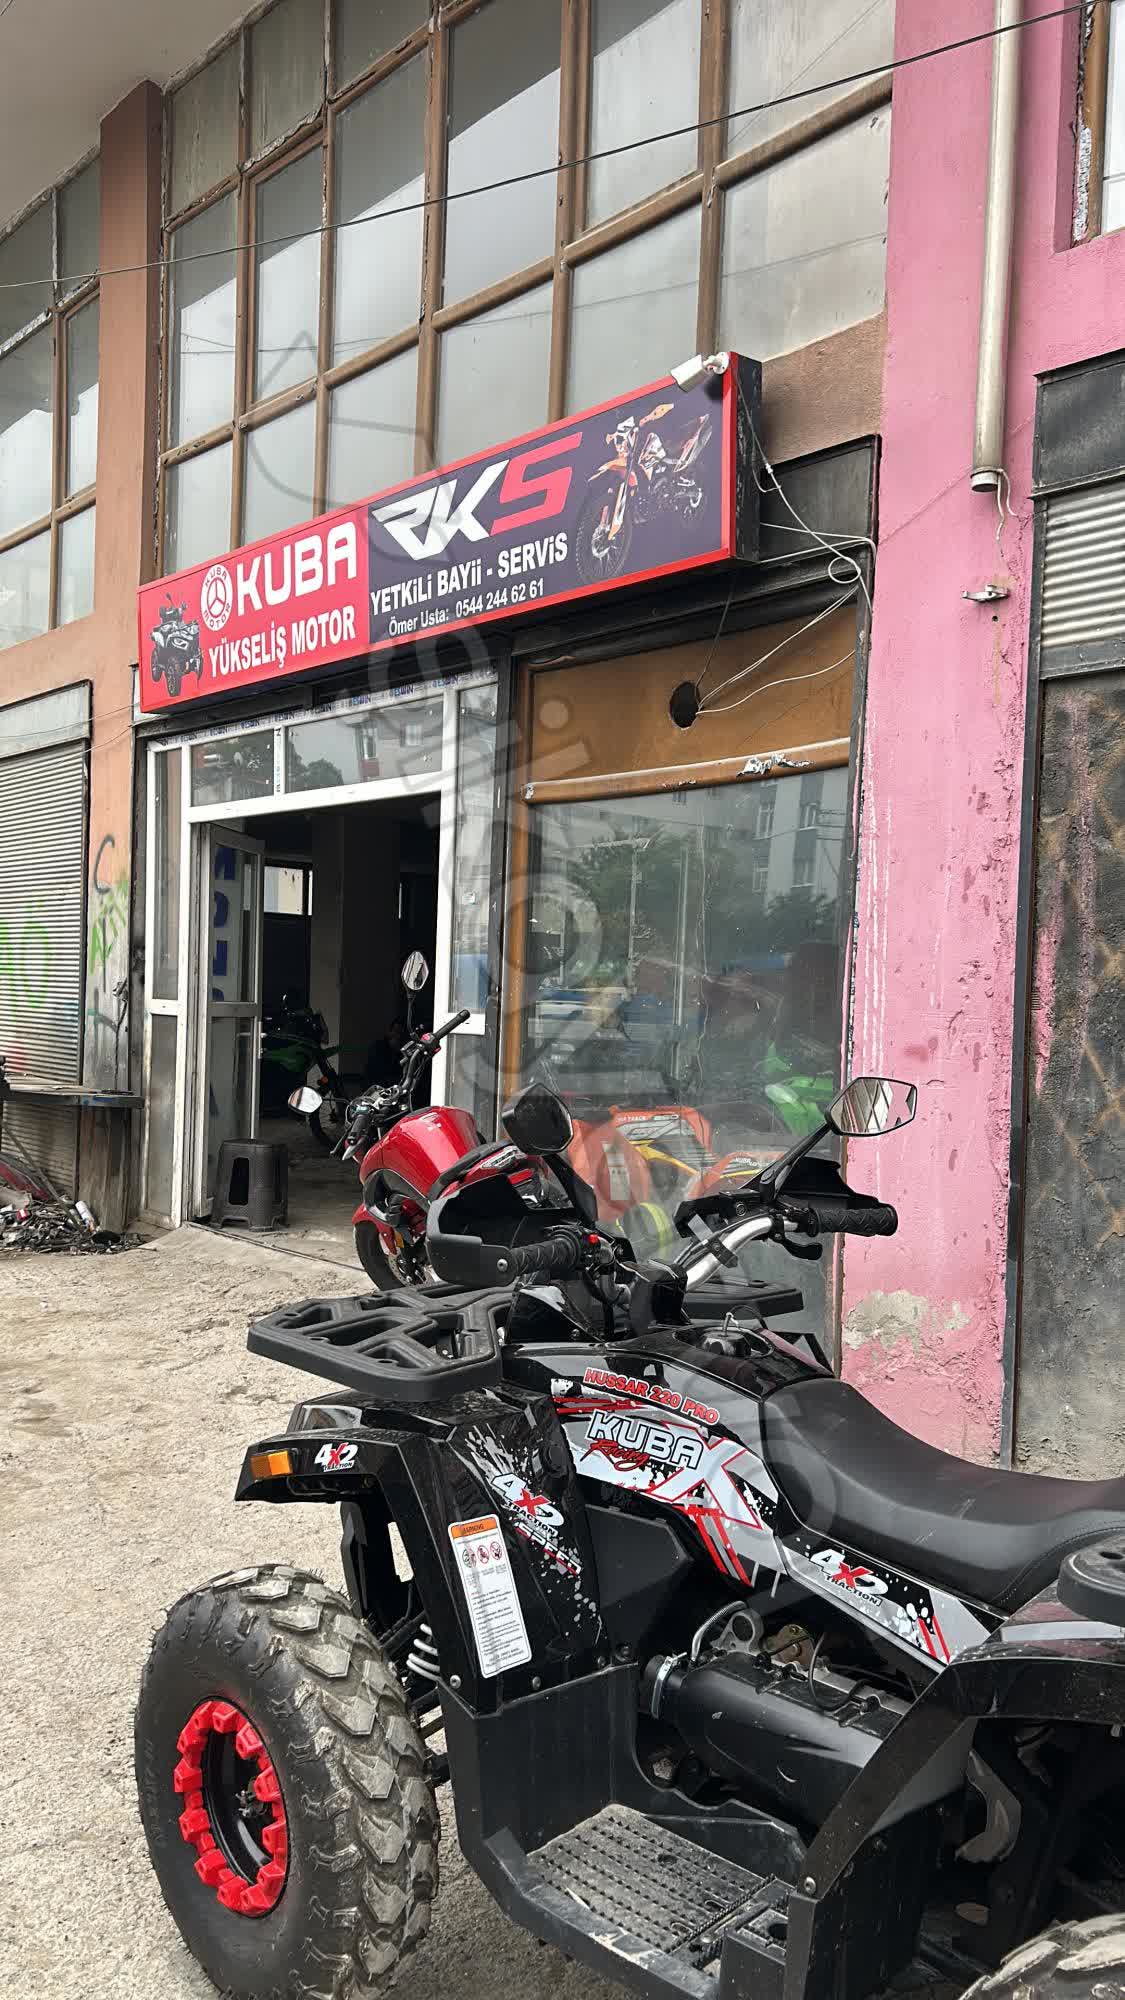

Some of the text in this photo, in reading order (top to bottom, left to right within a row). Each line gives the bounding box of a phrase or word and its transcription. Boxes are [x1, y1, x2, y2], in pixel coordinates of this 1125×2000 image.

[371, 431, 583, 561] RKS
[204, 566, 228, 588] KUBA
[236, 521, 357, 617] KUBA
[203, 602, 231, 628] MOTOR
[388, 577, 544, 636] Ömer Usta: 0544 244 62 61
[208, 604, 356, 678] YÜKSELİŞ MOTOR
[583, 1367, 720, 1425] HUSSAR 220 PRO
[580, 1439, 651, 1472] Racing
[586, 1410, 704, 1470] KUBA
[506, 1499, 558, 1538] TRACTION
[514, 1521, 582, 1576] SPEED
[825, 1575, 882, 1606] TRACTION
